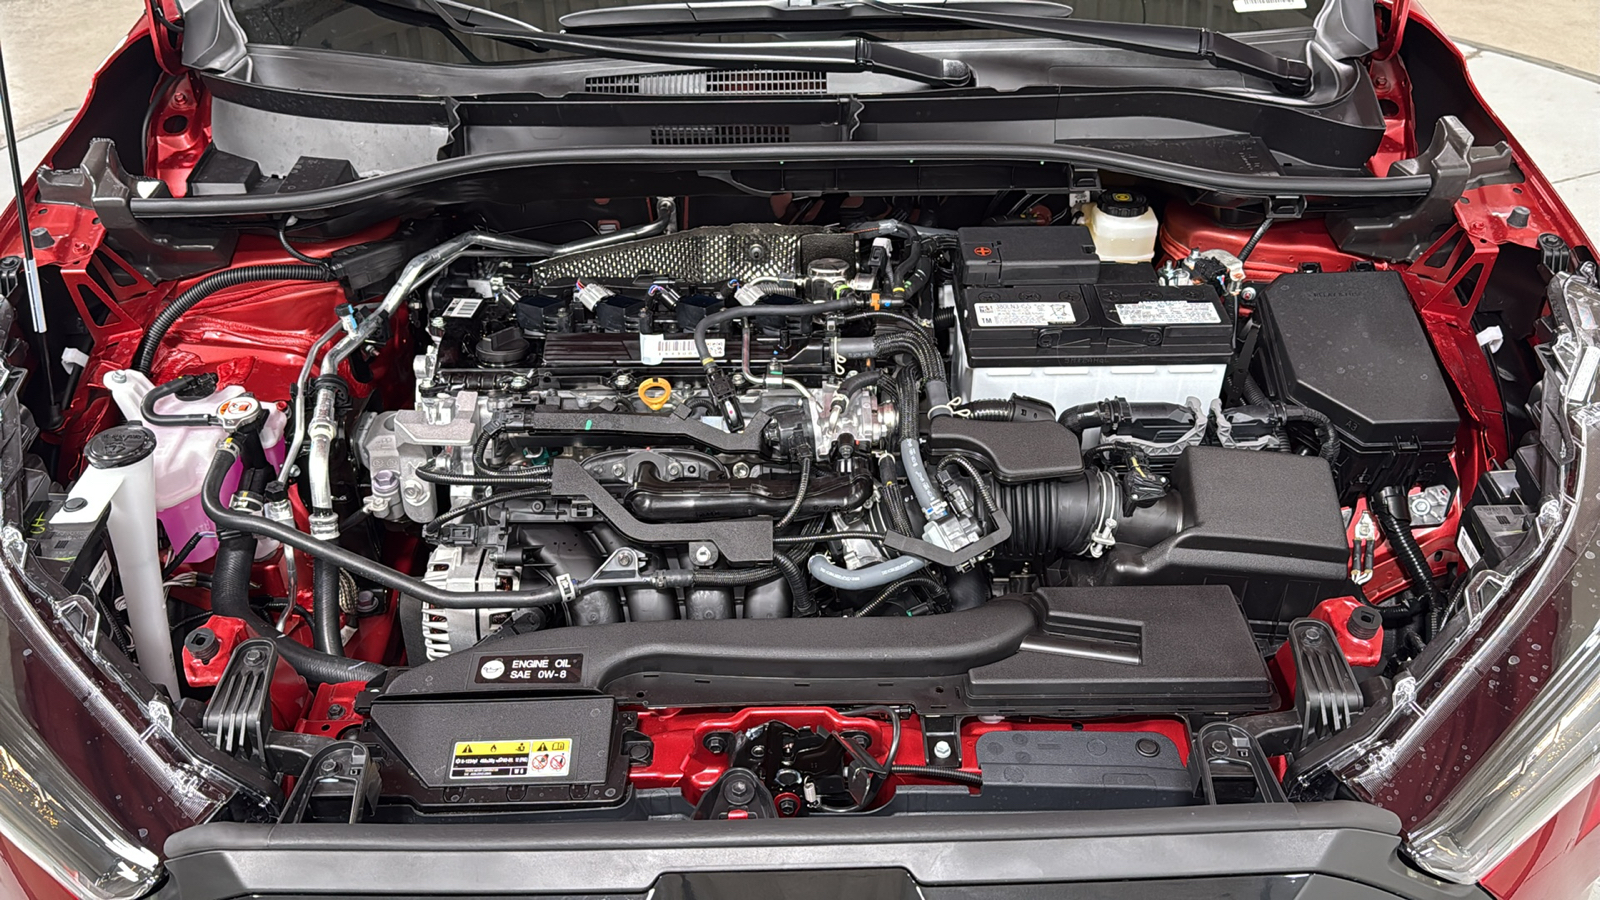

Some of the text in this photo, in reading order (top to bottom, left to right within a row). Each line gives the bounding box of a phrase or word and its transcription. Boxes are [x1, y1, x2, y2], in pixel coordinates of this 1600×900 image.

[512, 659, 571, 668] ENGINE OIL
[510, 670, 567, 679] SAE 0W-8
